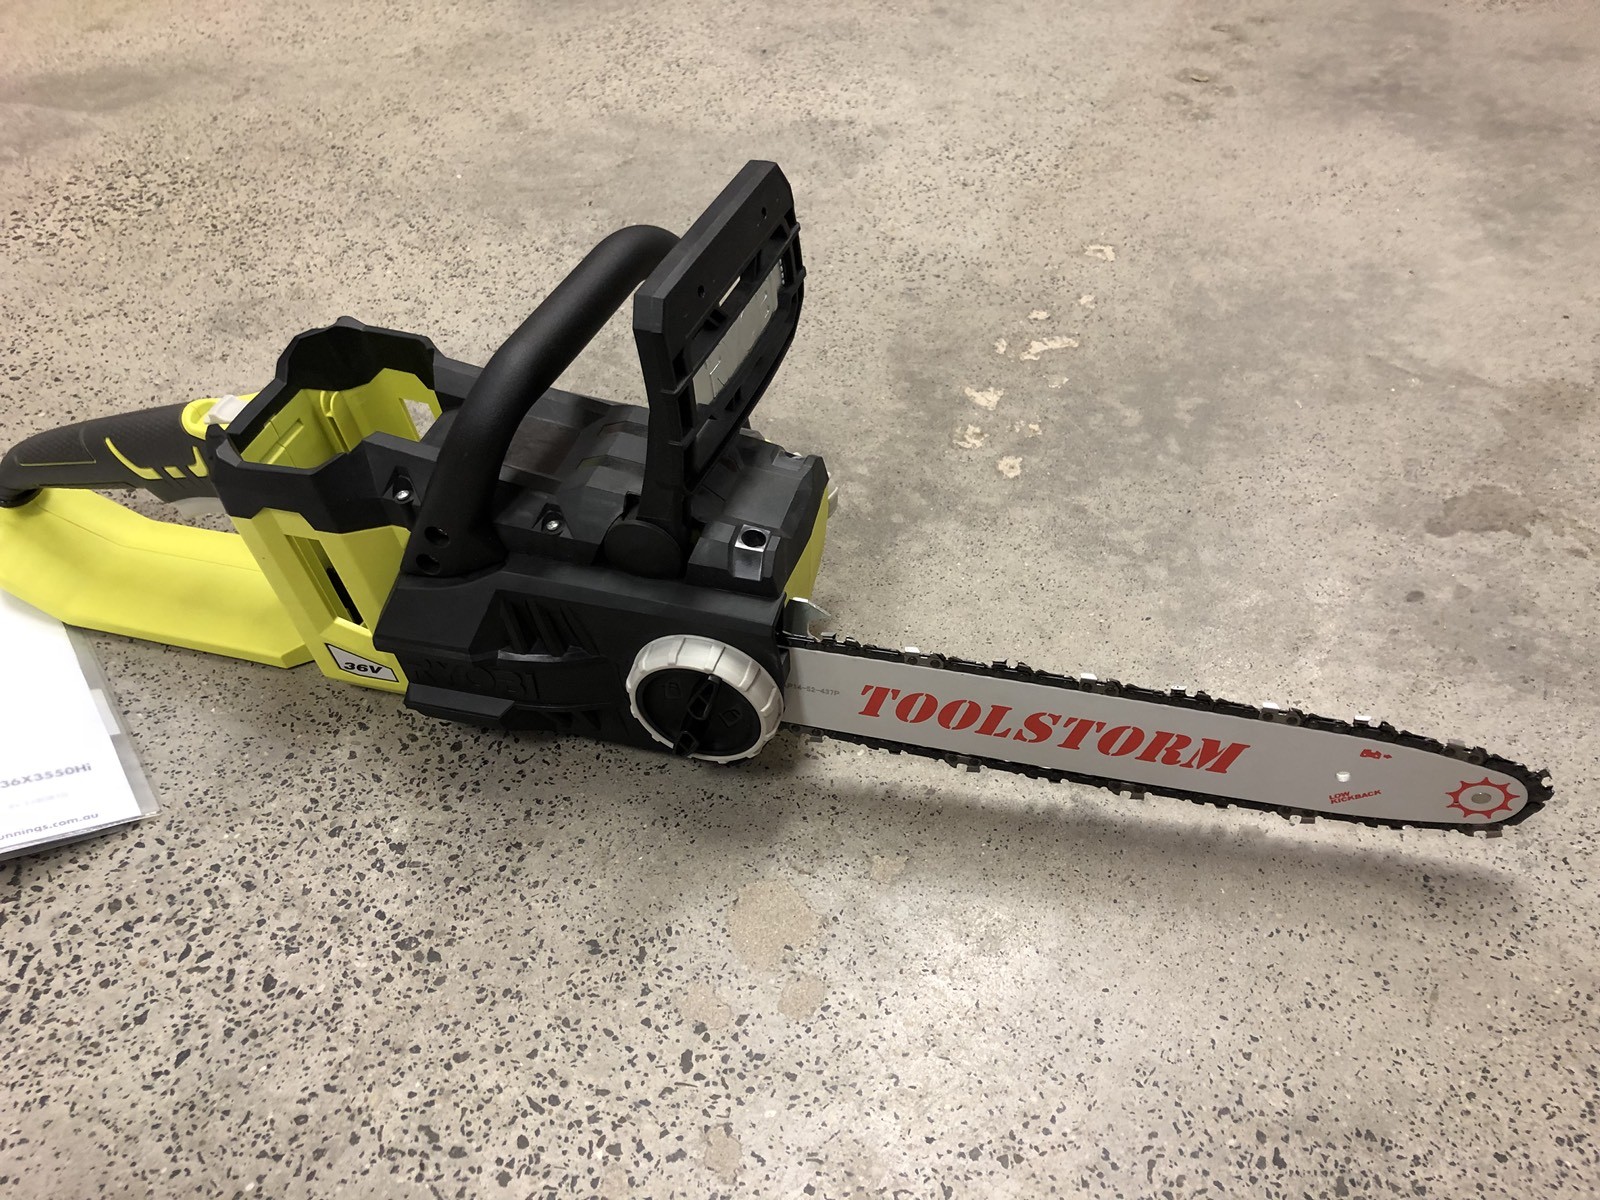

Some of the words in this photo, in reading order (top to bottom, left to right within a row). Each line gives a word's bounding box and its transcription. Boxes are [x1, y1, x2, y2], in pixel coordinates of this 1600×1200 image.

[343, 661, 383, 676] 36V
[858, 684, 1251, 774] TOOLSTORM
[1329, 791, 1350, 799] LOW
[1330, 790, 1382, 804] KICKBACK
